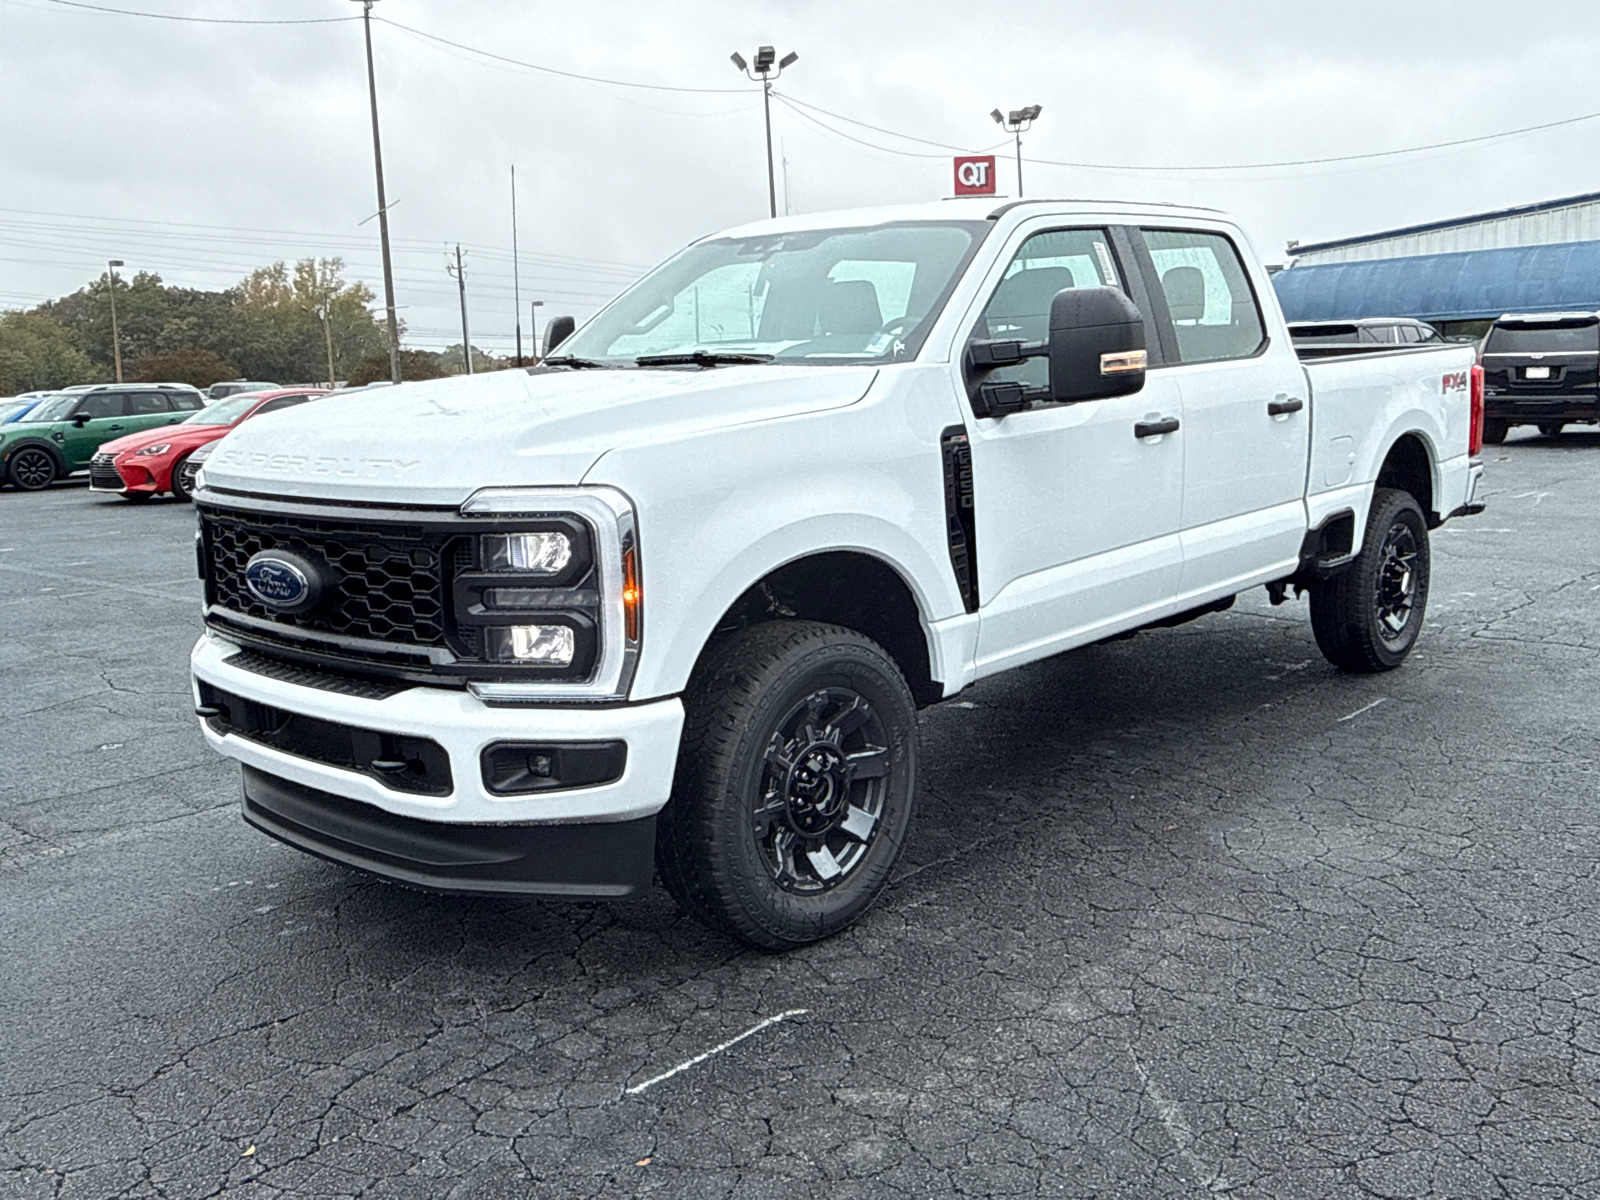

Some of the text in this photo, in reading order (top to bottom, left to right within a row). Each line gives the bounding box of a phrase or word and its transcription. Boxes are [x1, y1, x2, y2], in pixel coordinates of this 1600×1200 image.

[958, 162, 989, 187] QT
[1442, 371, 1467, 395] FX4
[216, 451, 421, 479] SUPER DUTY
[257, 567, 292, 597] Ford
